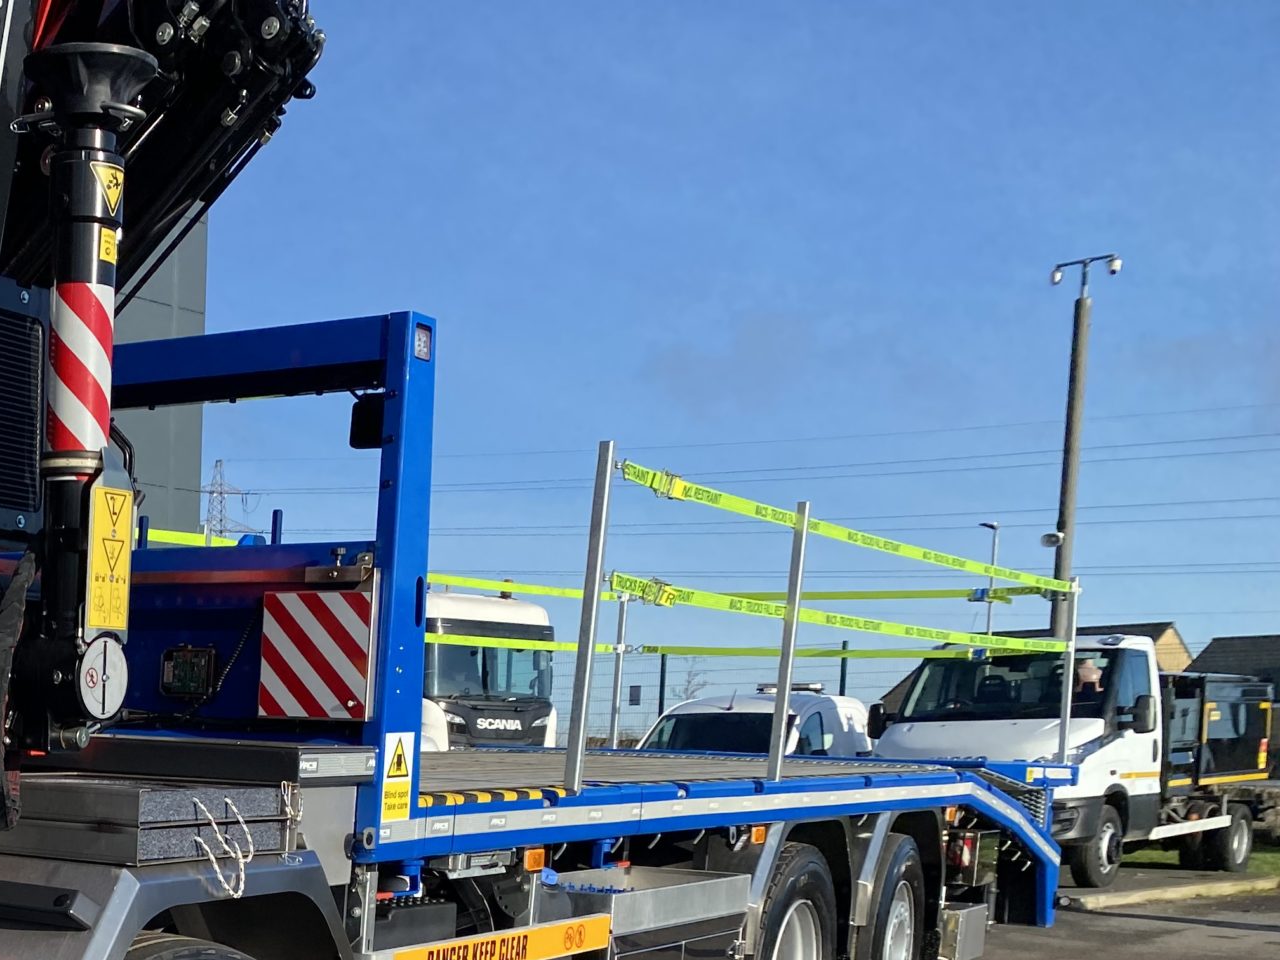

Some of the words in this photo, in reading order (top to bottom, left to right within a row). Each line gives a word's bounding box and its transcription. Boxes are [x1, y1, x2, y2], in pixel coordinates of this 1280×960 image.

[476, 718, 522, 731] SCANIA
[384, 790, 397, 799] Blind
[398, 789, 409, 801] spot
[384, 802, 396, 811] Take
[397, 802, 408, 811] care
